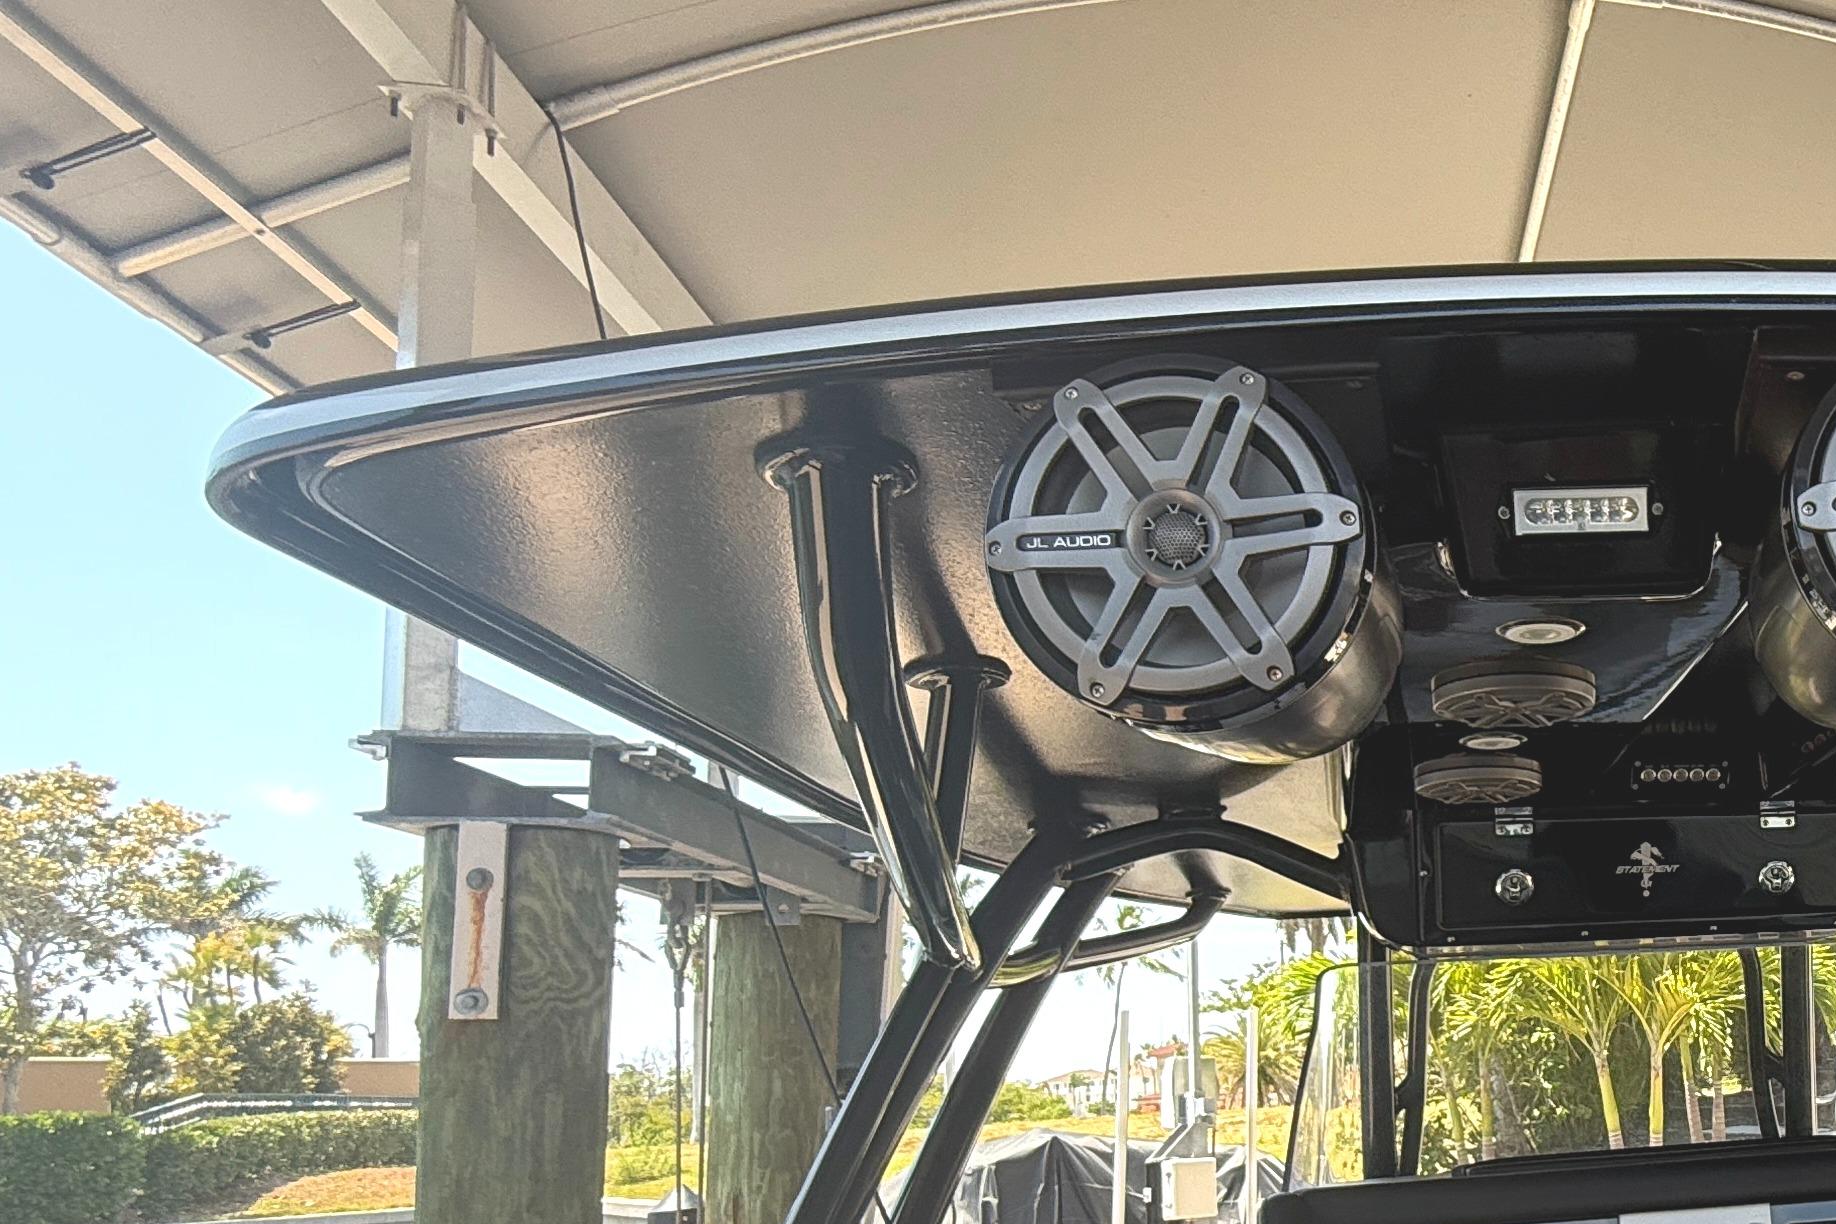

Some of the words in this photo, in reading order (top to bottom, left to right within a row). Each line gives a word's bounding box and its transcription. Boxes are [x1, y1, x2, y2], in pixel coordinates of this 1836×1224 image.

[1026, 537, 1049, 548] JL
[1053, 534, 1111, 548] AUDIO
[1615, 864, 1680, 874] STATEMENT
